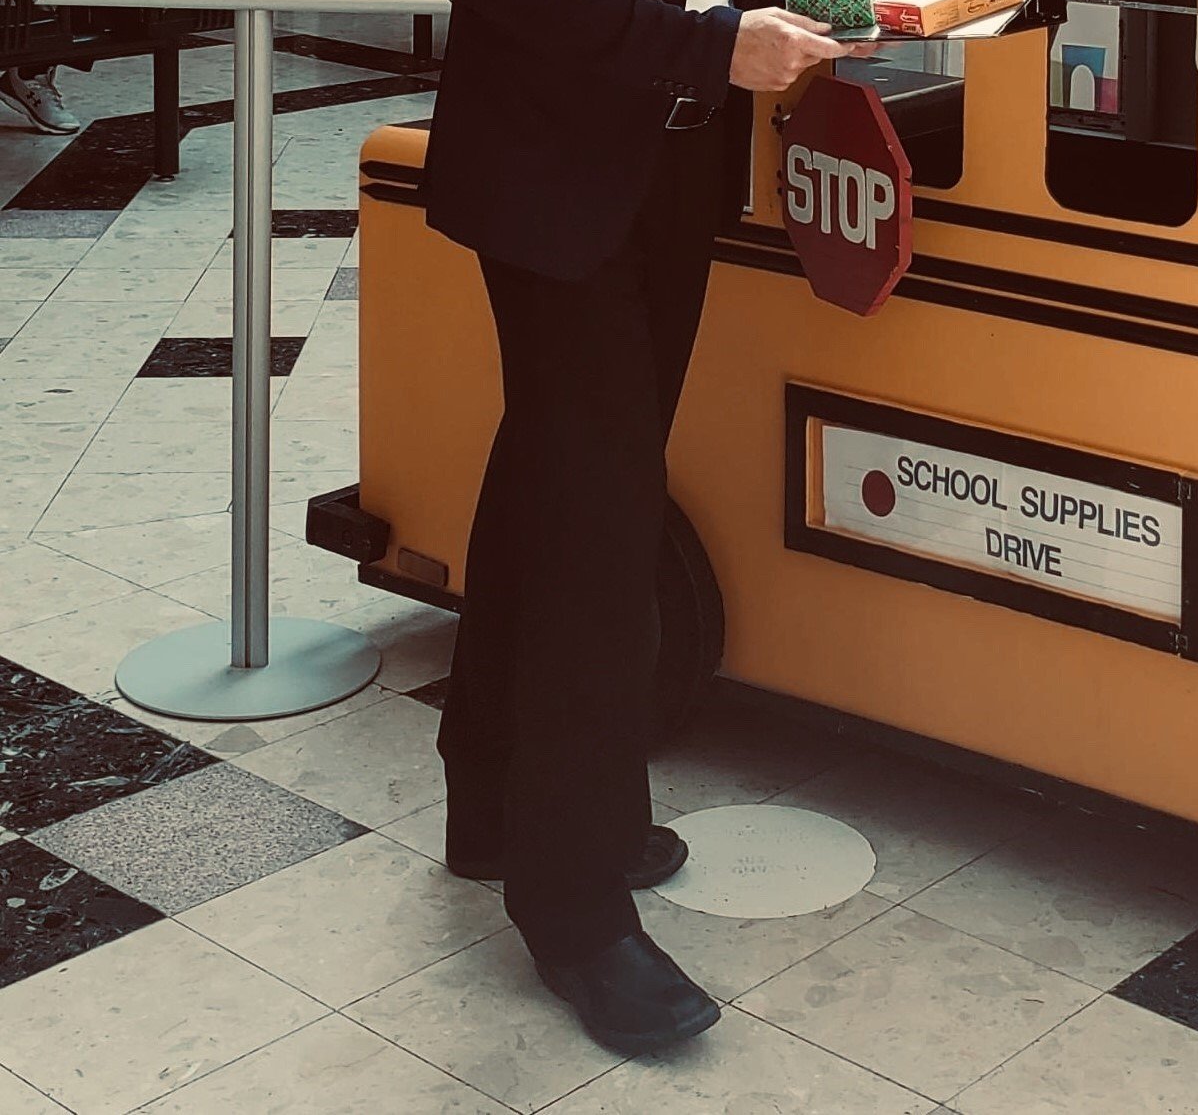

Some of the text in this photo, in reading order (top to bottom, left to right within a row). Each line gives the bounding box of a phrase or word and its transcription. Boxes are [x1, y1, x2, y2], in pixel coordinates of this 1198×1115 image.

[787, 144, 895, 250] STOP
[897, 455, 1161, 547] SCHOOL SUPPLIES
[985, 527, 1062, 577] DRIVE
